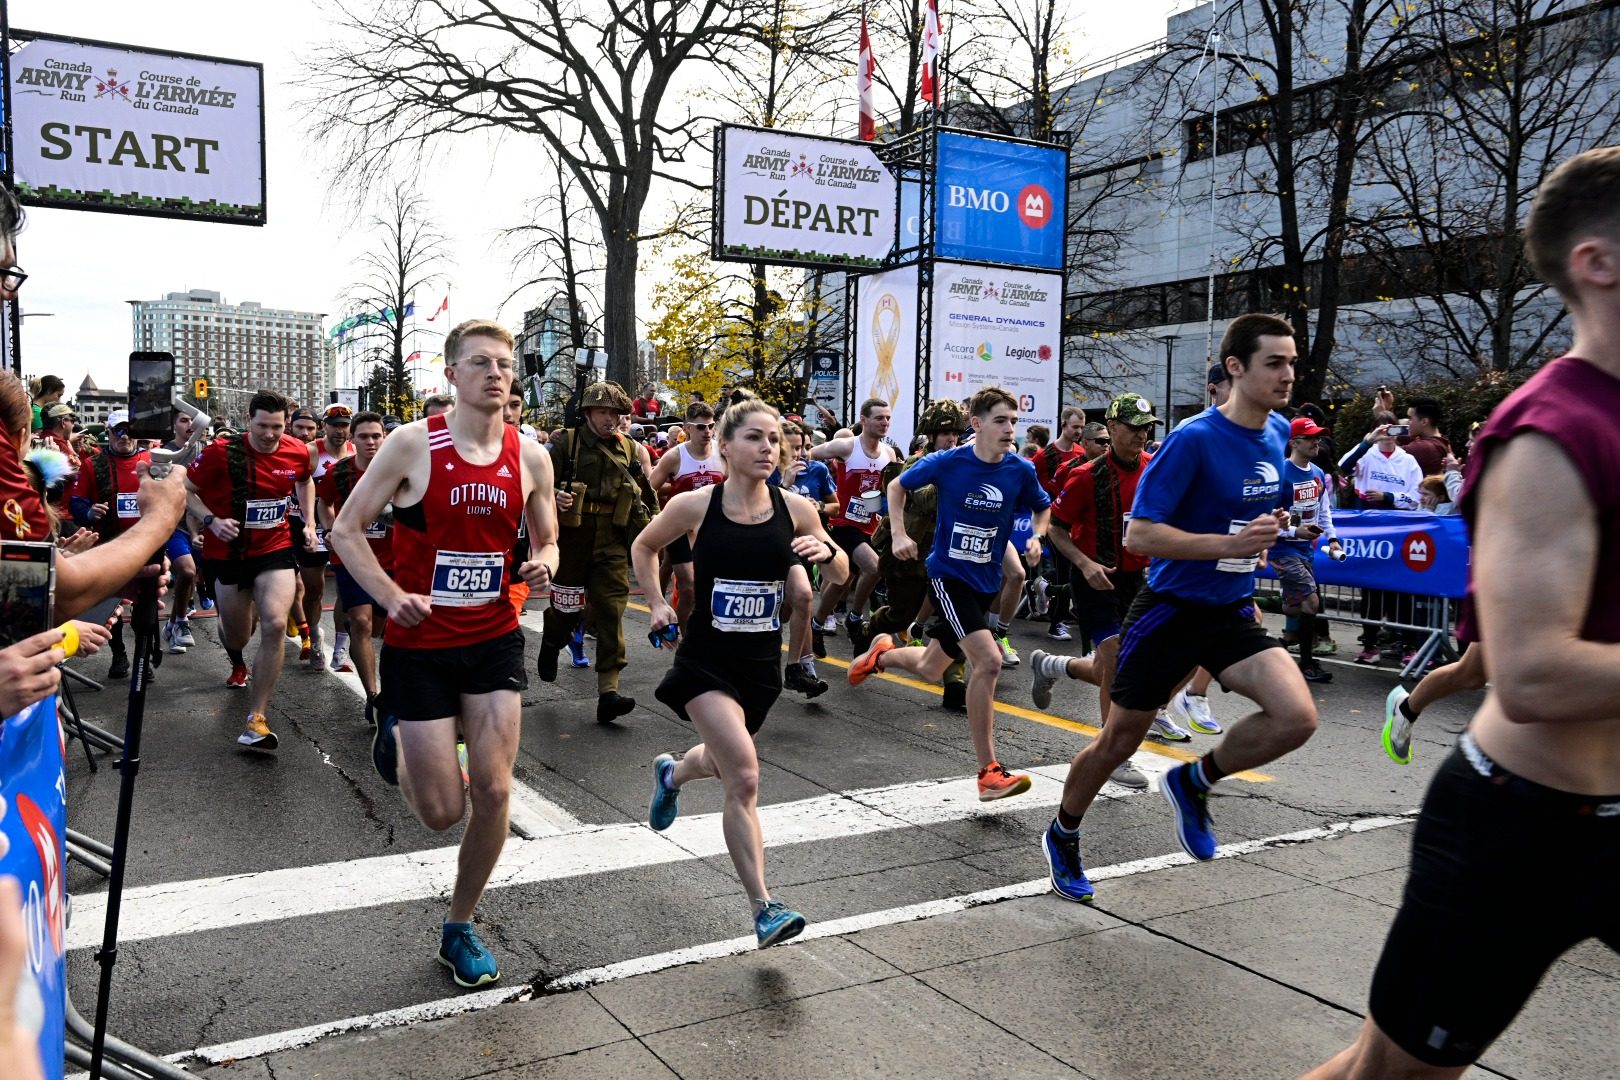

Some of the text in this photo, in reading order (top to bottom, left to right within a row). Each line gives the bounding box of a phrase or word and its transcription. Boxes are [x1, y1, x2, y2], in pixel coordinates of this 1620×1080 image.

[44, 58, 92, 74] Canada
[15, 67, 91, 91] ARMY
[139, 70, 201, 87] Course de
[60, 90, 86, 102] Run
[135, 81, 236, 109] L'ARMÉE
[133, 98, 199, 116] du Canada
[40, 122, 219, 175] START
[760, 146, 791, 159] Canada
[742, 154, 790, 172] ARMY
[819, 154, 859, 167] Course de
[769, 171, 786, 182] Run
[817, 163, 881, 184] L'ARMÉE
[814, 177, 857, 190] du Canada
[948, 185, 1010, 213] BMO
[743, 189, 879, 237] DÉPART
[961, 276, 983, 285] Canada
[1003, 281, 1024, 290] Course
[948, 283, 982, 296] ARMY
[1001, 288, 1048, 302] L'ARMÉE
[967, 295, 980, 303] Run
[1009, 300, 1031, 308] Canada
[949, 313, 1045, 328] GENERAL DYNAMICS
[944, 342, 975, 354] Accora
[1005, 345, 1037, 360] Legion
[1018, 417, 1053, 425] SSIONAIRES
[450, 483, 507, 509] OTTAWA
[1243, 484, 1280, 496] ESPOIR
[125, 500, 139, 510] 52
[466, 505, 492, 515] LIONS
[965, 497, 1002, 509] ESPOIR
[256, 507, 278, 520] 7211
[961, 536, 990, 552] 6154
[1343, 538, 1394, 560] BMO
[446, 568, 492, 590] 6259
[724, 595, 765, 617] 7300
